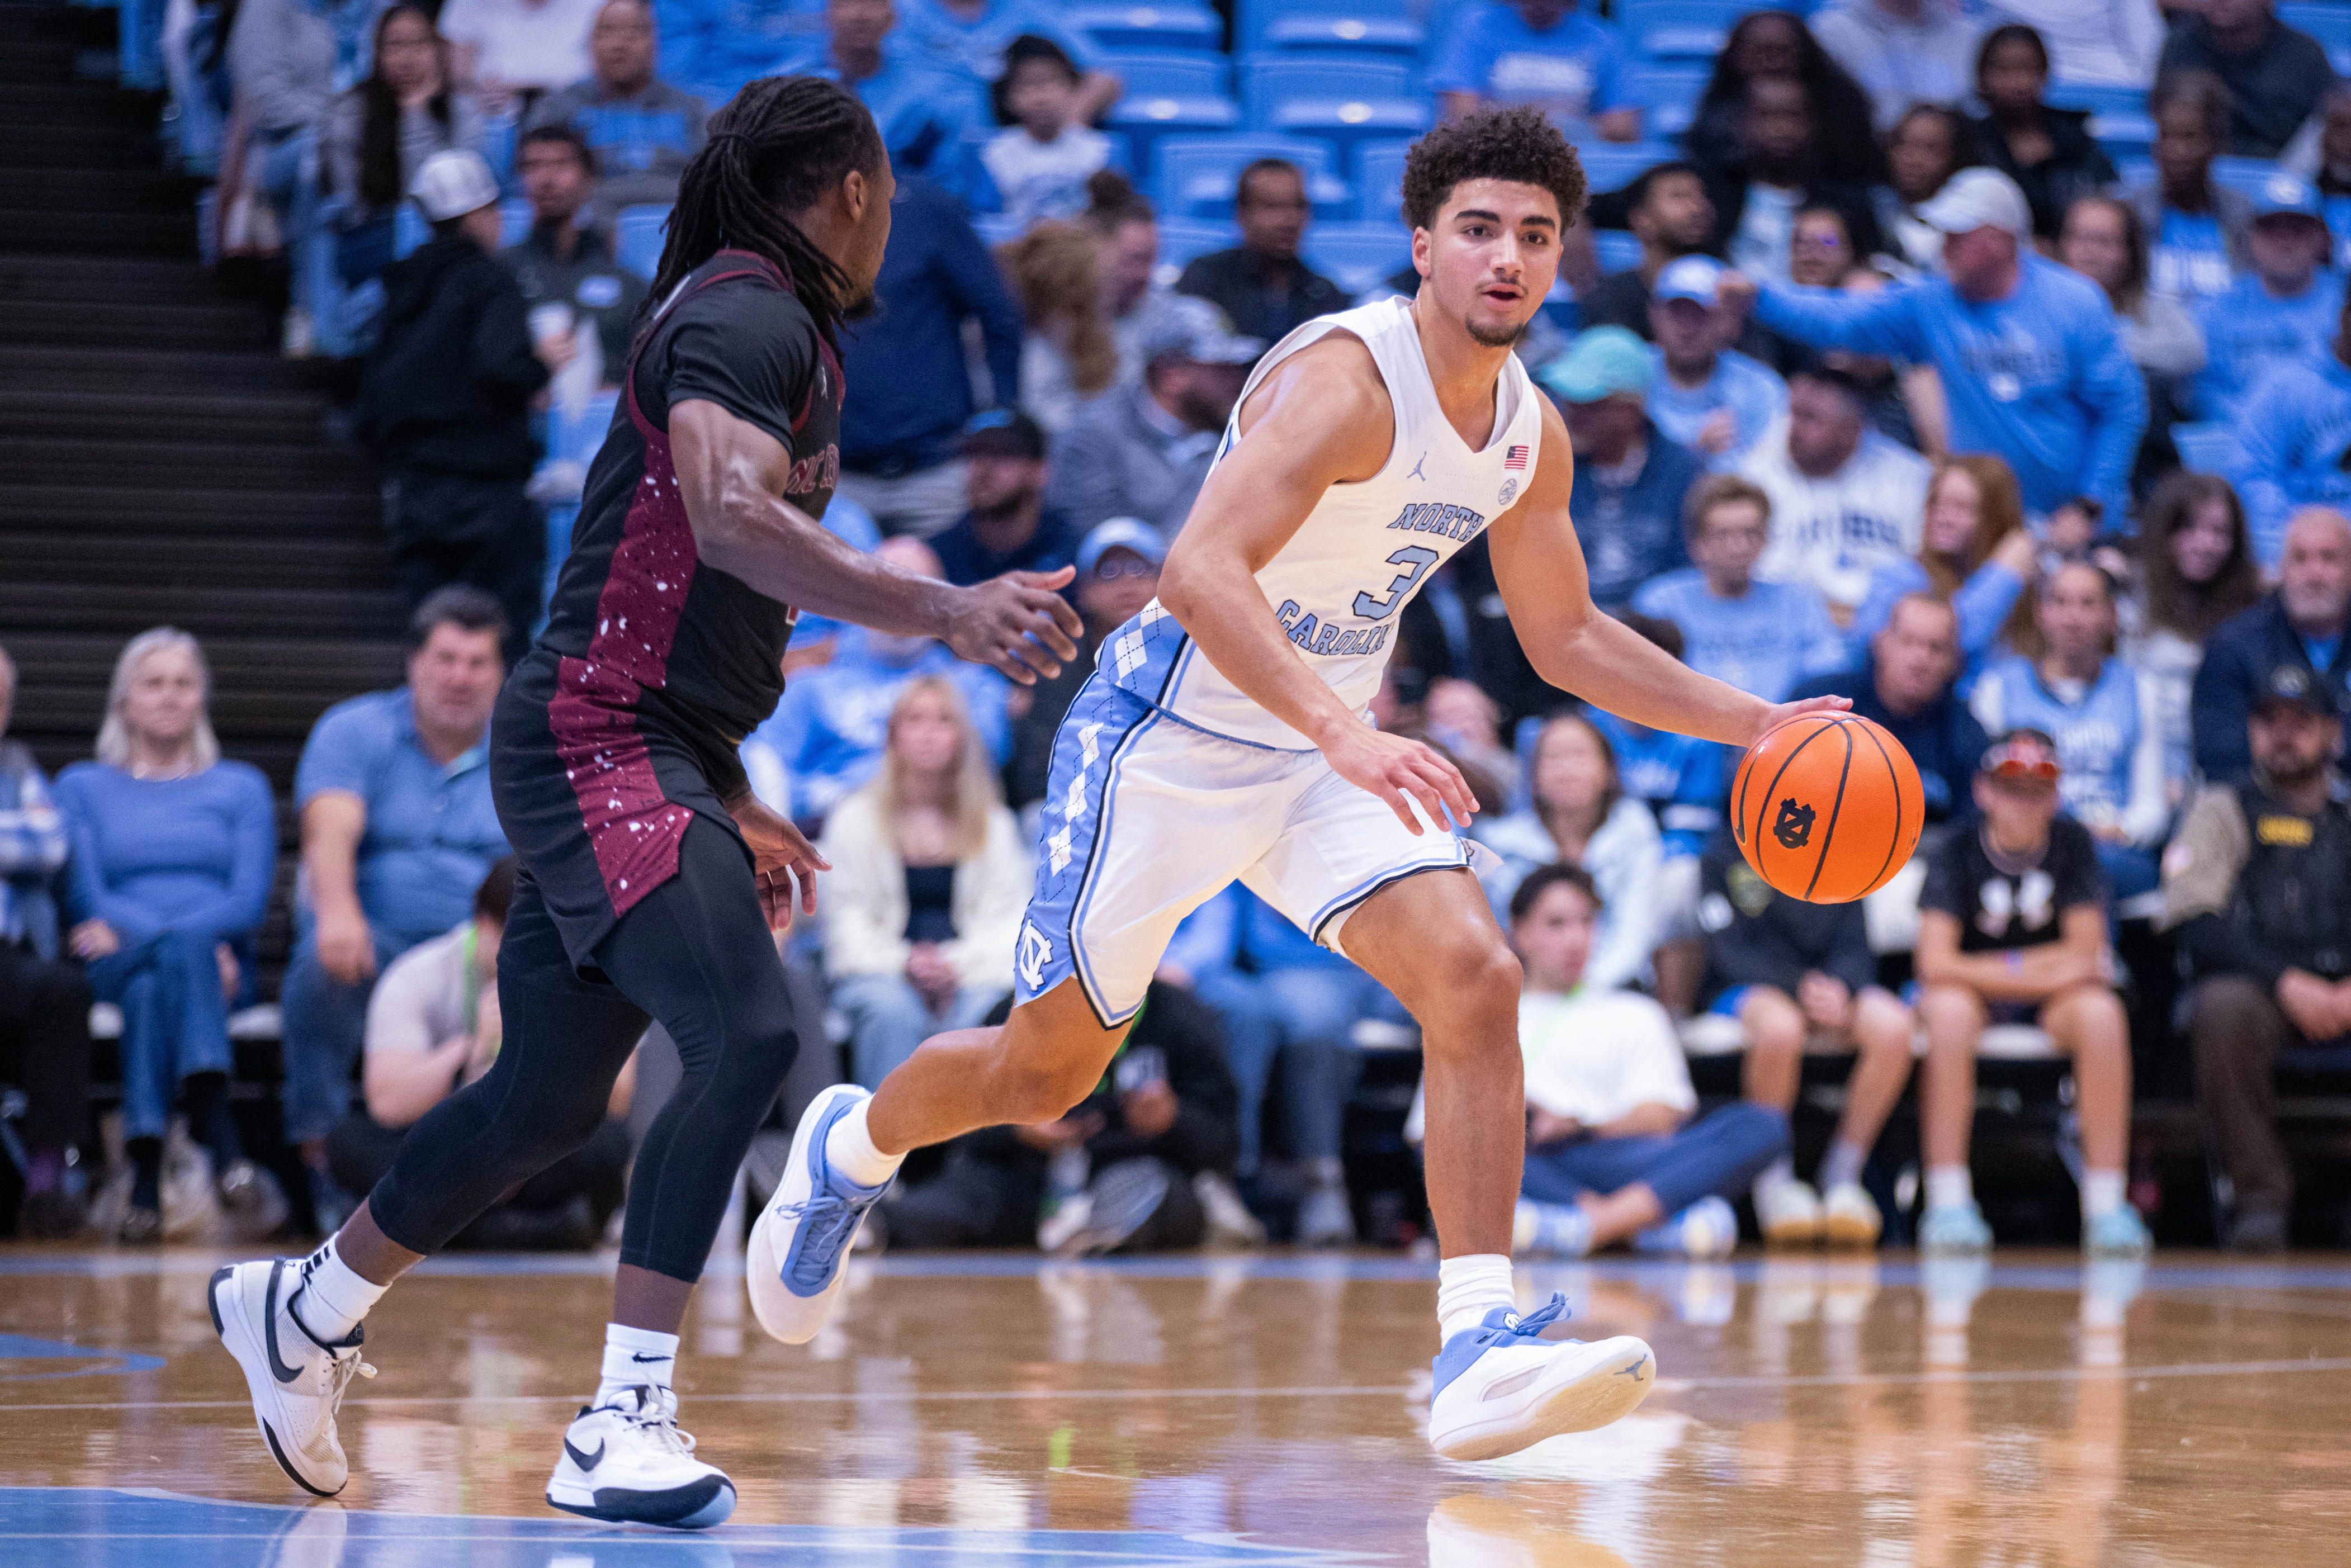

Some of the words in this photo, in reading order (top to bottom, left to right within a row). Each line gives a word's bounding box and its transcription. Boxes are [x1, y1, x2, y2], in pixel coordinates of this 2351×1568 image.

[1385, 503, 1485, 543] NORTH
[1352, 545, 1440, 620] 3
[1275, 599, 1397, 656] CAROLIN
